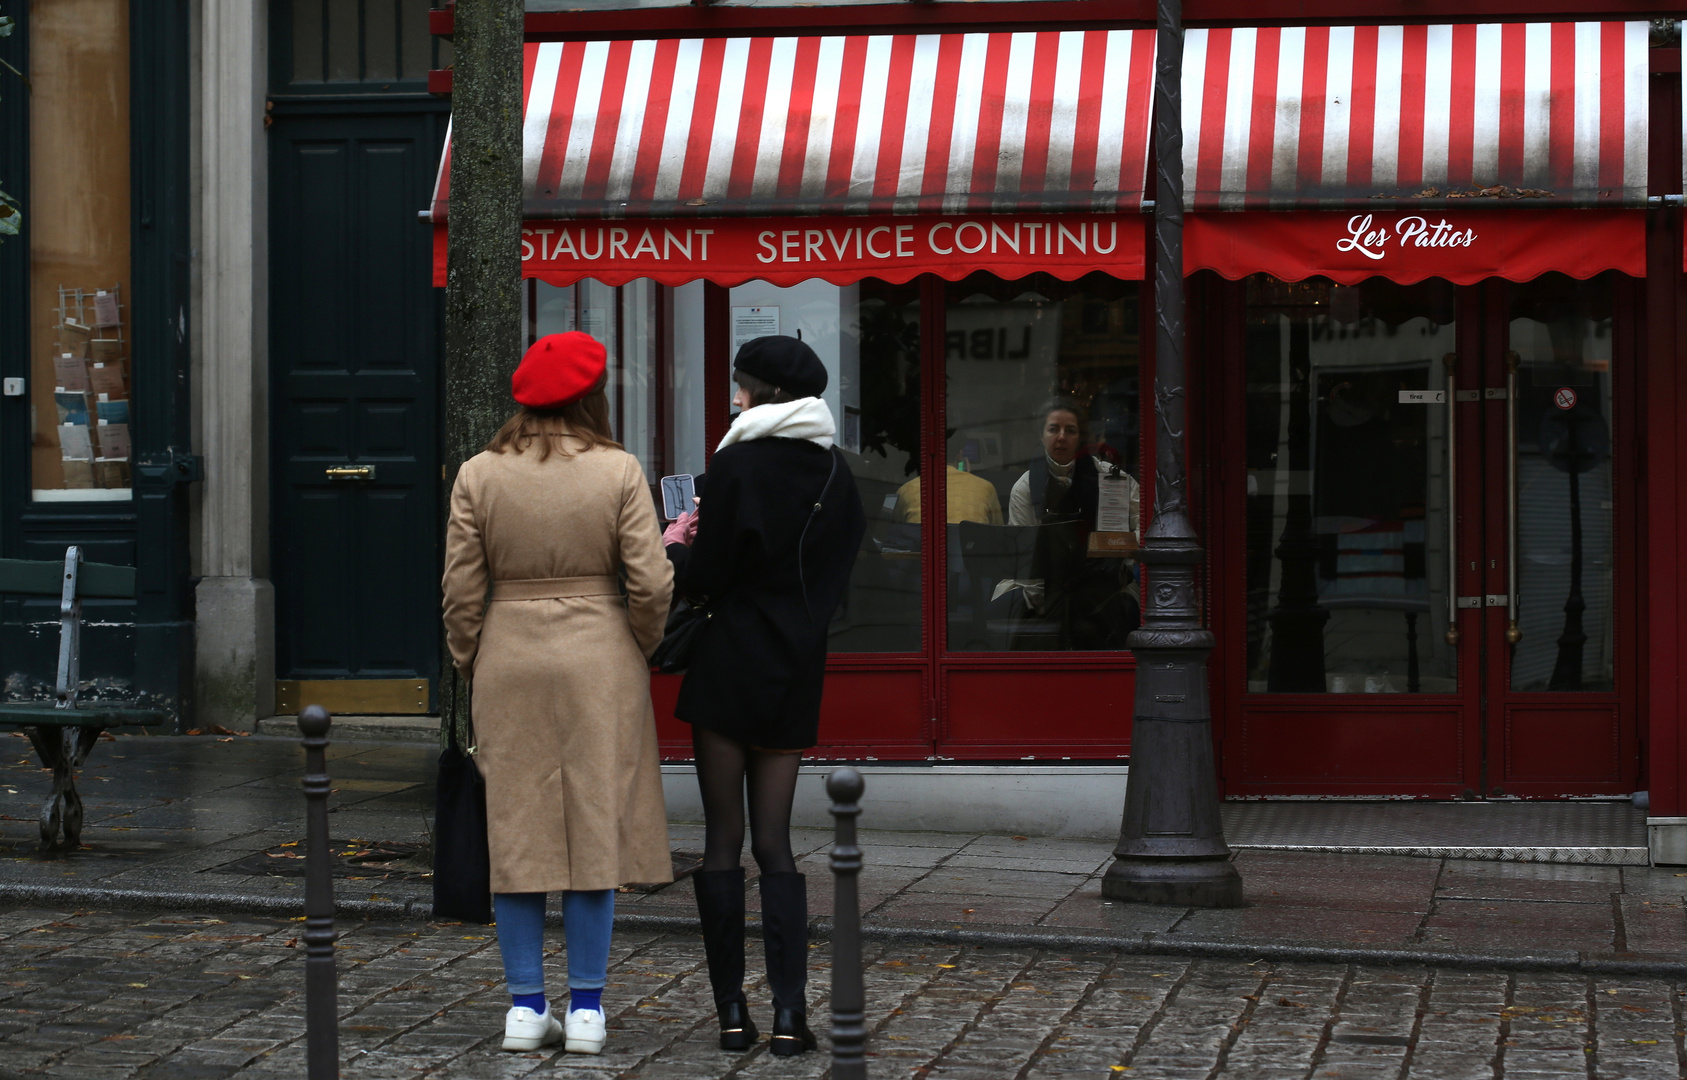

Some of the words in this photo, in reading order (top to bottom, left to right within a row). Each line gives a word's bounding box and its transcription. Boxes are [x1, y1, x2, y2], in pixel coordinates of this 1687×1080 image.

[521, 228, 714, 261] STAURANT
[756, 225, 914, 263] SERVICE
[928, 221, 1117, 255] CONTINU
[1337, 214, 1391, 259] Les
[1396, 216, 1477, 247] Patios
